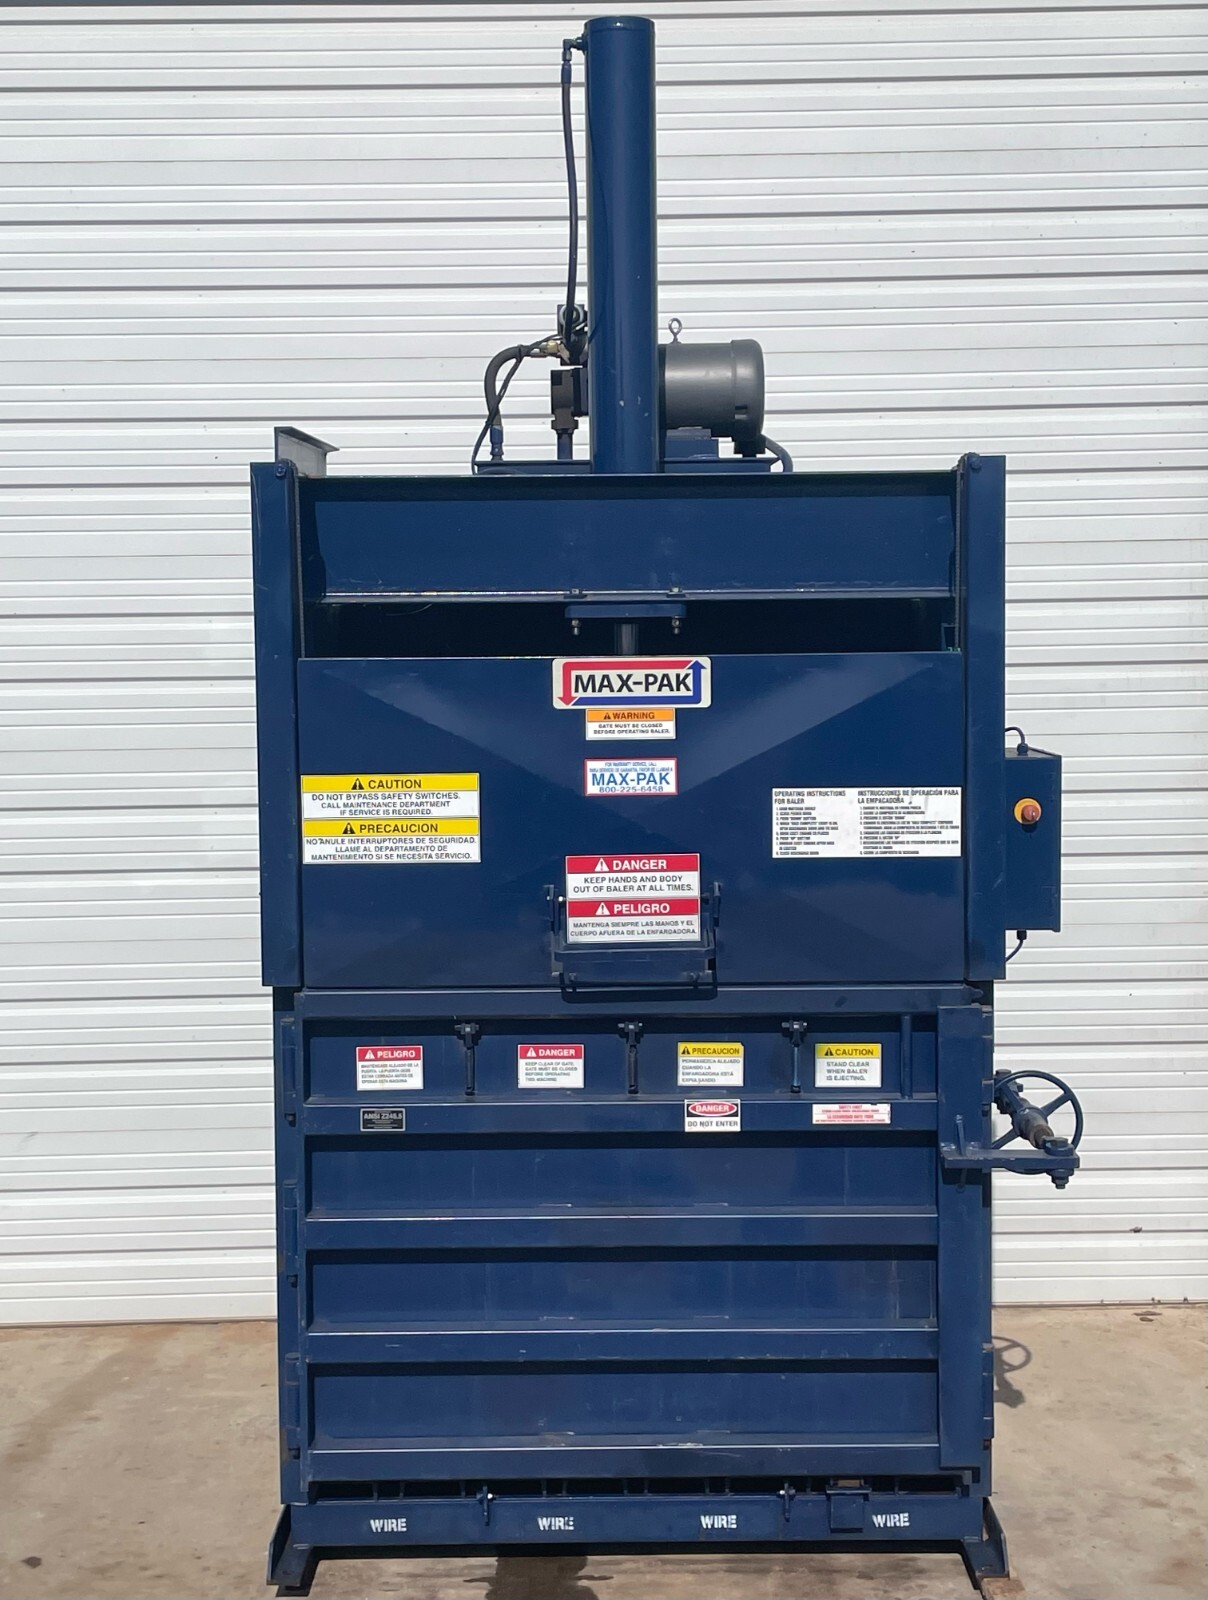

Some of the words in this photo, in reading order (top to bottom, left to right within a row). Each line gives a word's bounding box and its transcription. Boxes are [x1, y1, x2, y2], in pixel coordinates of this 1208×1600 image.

[574, 673, 692, 693] MAX-PAK
[368, 780, 421, 789] CAUTION
[592, 773, 670, 785] MAX-PAK
[360, 824, 438, 833] PRECAUCION
[613, 860, 666, 870] DANGER
[614, 903, 670, 914] PELIGRO
[370, 1518, 407, 1533] WIRE
[537, 1516, 574, 1531] WIRE
[701, 1514, 737, 1529] WIRE
[872, 1513, 910, 1528] WIRE
